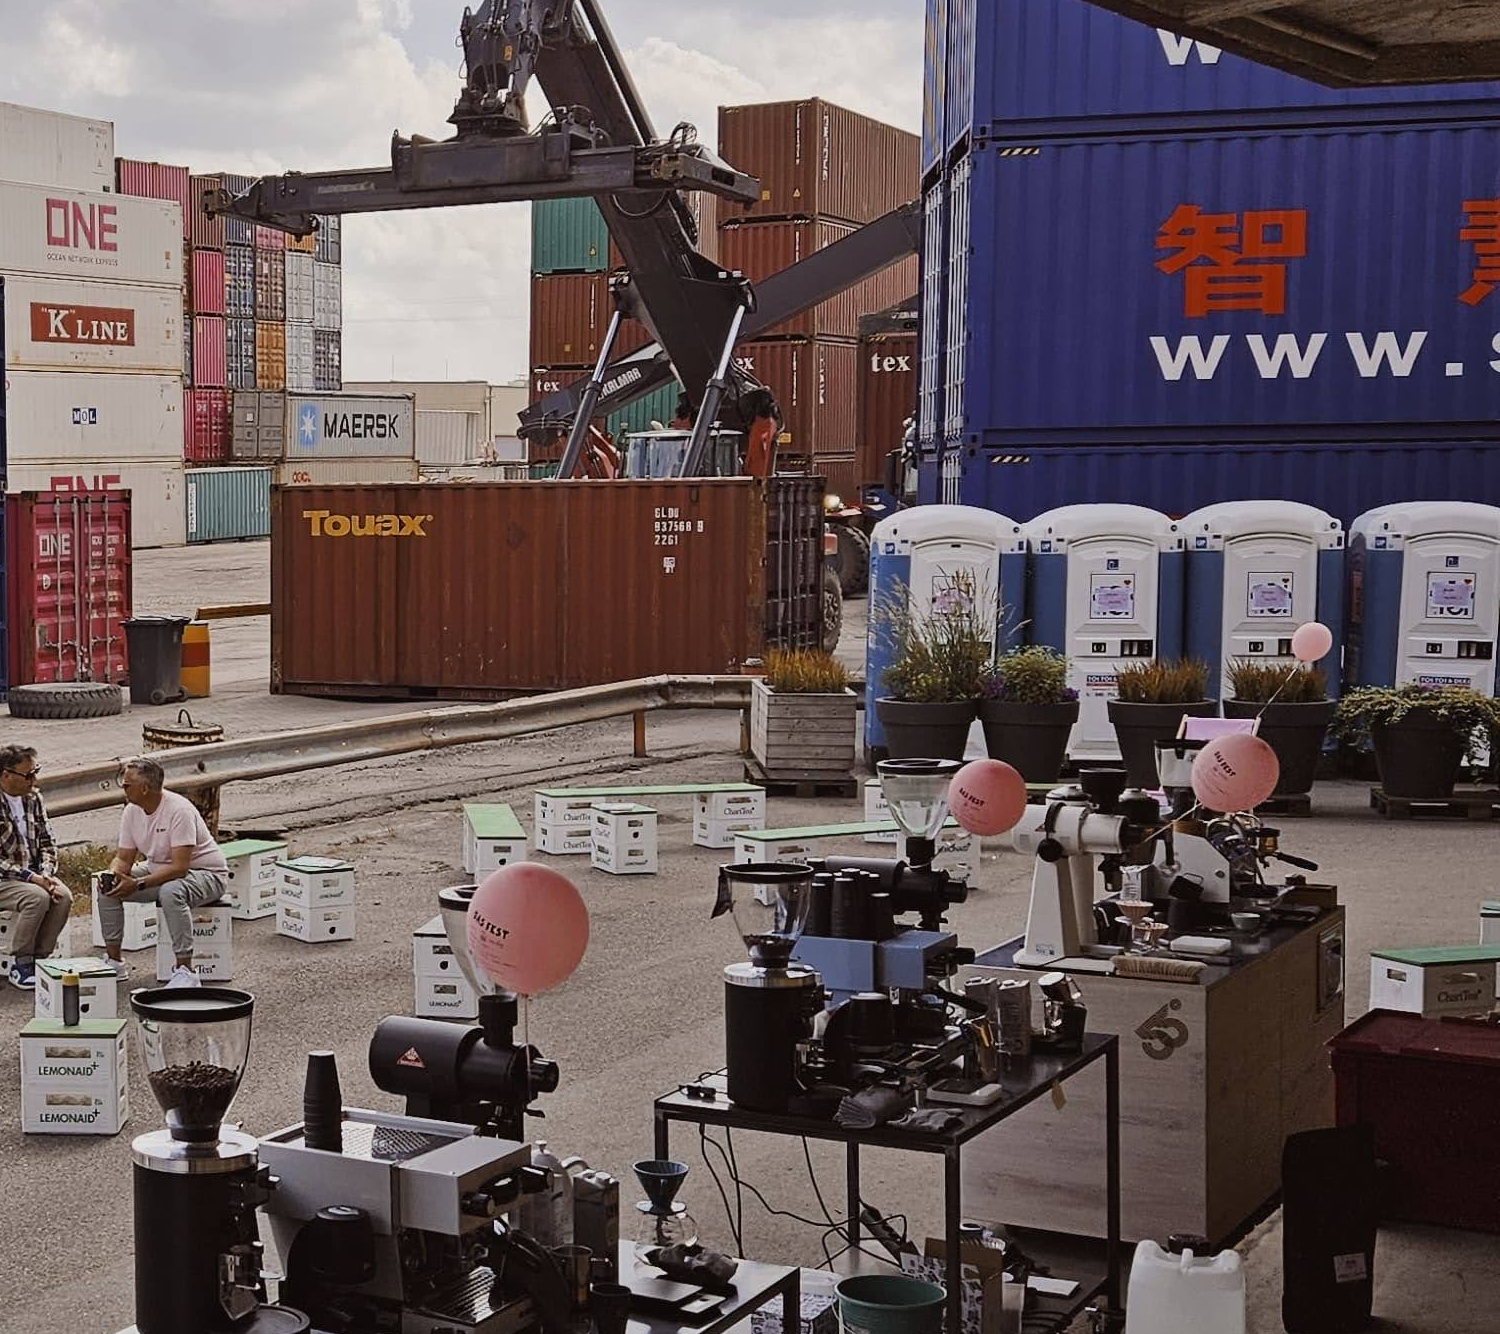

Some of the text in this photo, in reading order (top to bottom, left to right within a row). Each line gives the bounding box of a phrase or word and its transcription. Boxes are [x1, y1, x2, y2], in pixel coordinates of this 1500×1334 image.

[46, 198, 118, 252] ONE
[76, 320, 129, 342] LINE
[871, 352, 912, 373] tex
[1149, 330, 1500, 381] www.
[536, 378, 561, 392] tex
[72, 408, 97, 425] MOL
[323, 412, 400, 439] MAERSK
[654, 507, 680, 519] GLDU
[39, 533, 71, 556] ONE
[1221, 762, 1236, 776] FEST
[968, 794, 985, 807] FEST
[485, 922, 510, 940] FEST
